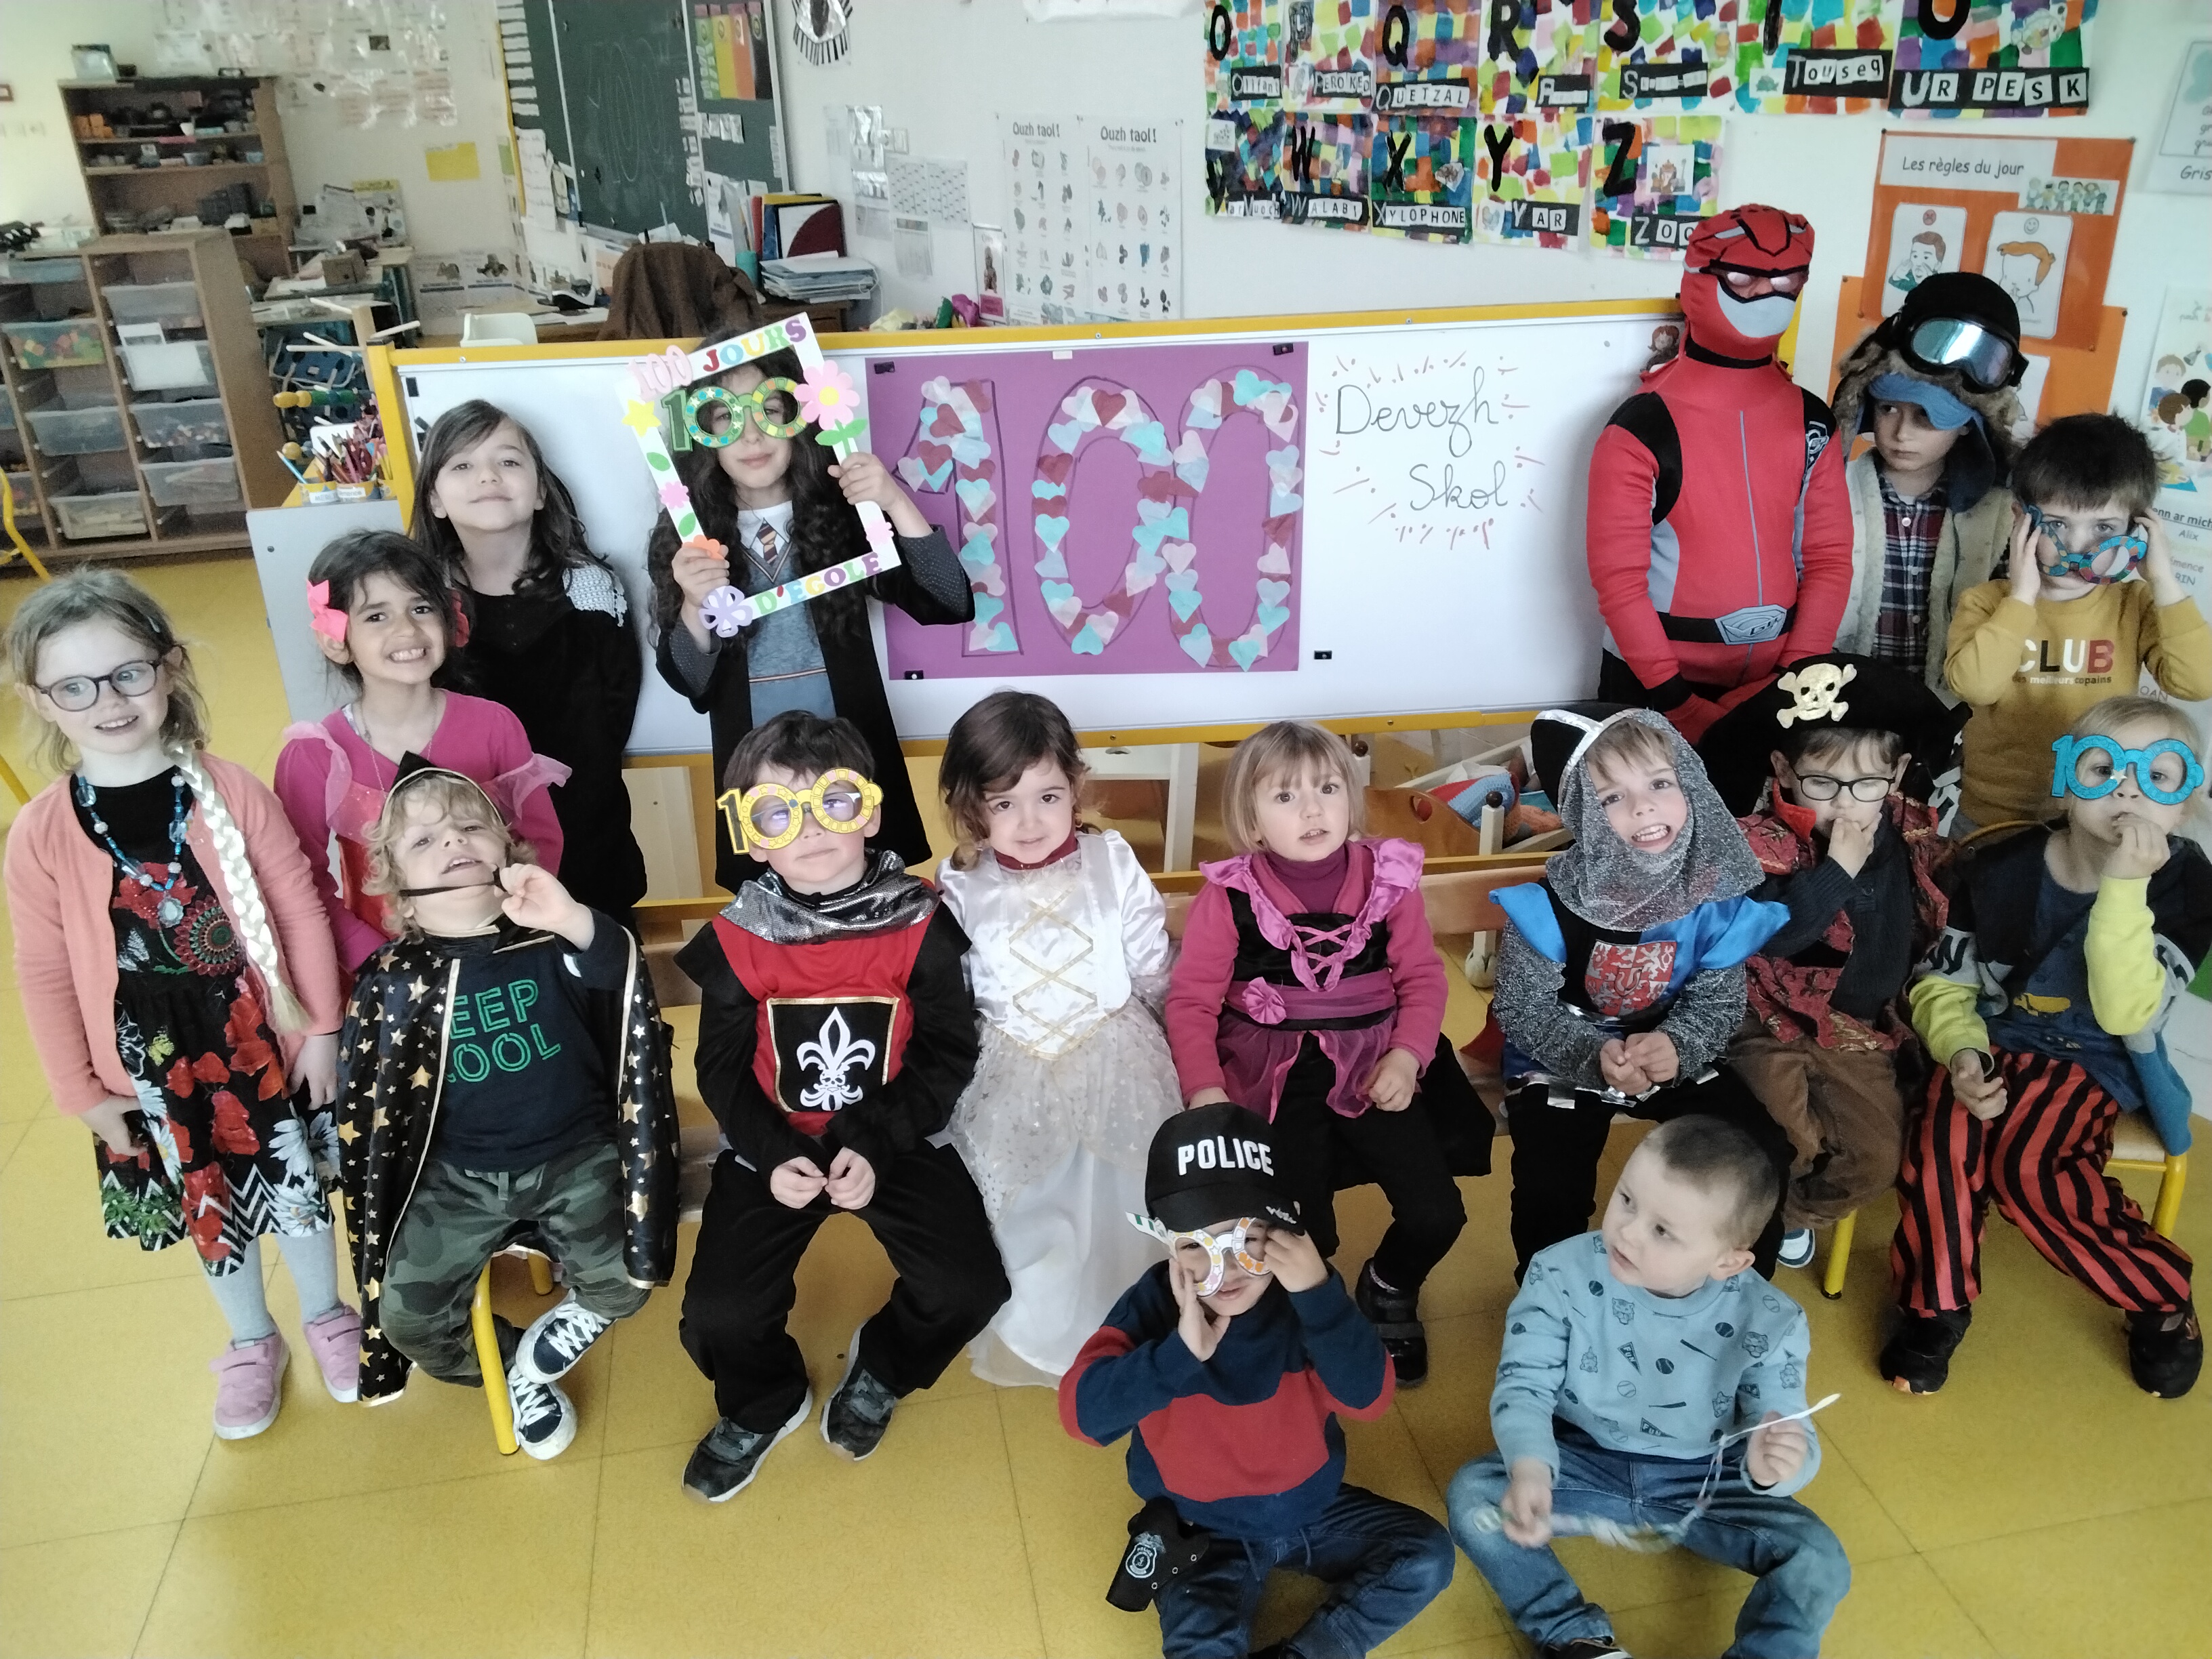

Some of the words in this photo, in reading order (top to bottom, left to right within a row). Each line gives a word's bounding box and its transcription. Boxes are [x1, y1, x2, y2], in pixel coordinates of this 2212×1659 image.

[1382, 5, 1410, 68] Q
[1488, 0, 1521, 62] R
[1376, 85, 1465, 110] QUETZAL
[1901, 71, 1951, 107] UR
[1980, 77, 2081, 100] PESK
[1012, 122, 1034, 136] Ouzh
[1101, 126, 1126, 141] Ouzh
[1292, 125, 1315, 184] W
[1384, 131, 1412, 194] X
[1483, 124, 1514, 192] Y
[1603, 121, 1637, 197] Z
[1903, 157, 1924, 171] Les
[1929, 157, 1969, 176] règles
[1975, 159, 1991, 175] du
[1994, 160, 2024, 179] jour
[1290, 193, 1357, 218] WALABI
[1374, 205, 1465, 226] XYLOPHONE
[1513, 199, 1563, 228] YAR
[703, 318, 806, 372] JOURS
[1336, 366, 1499, 457] Devezh
[1409, 460, 1508, 511] Skol
[893, 365, 1302, 669] 100
[2173, 513, 2185, 521] ar
[2018, 638, 2115, 674] CLUB
[2051, 735, 2202, 805] 100
[716, 767, 880, 855] 100
[449, 979, 539, 1041] EEP
[447, 1023, 561, 1083] OOL
[1177, 1135, 1275, 1176] POLICE
[1137, 1547, 1153, 1557] POLICE
